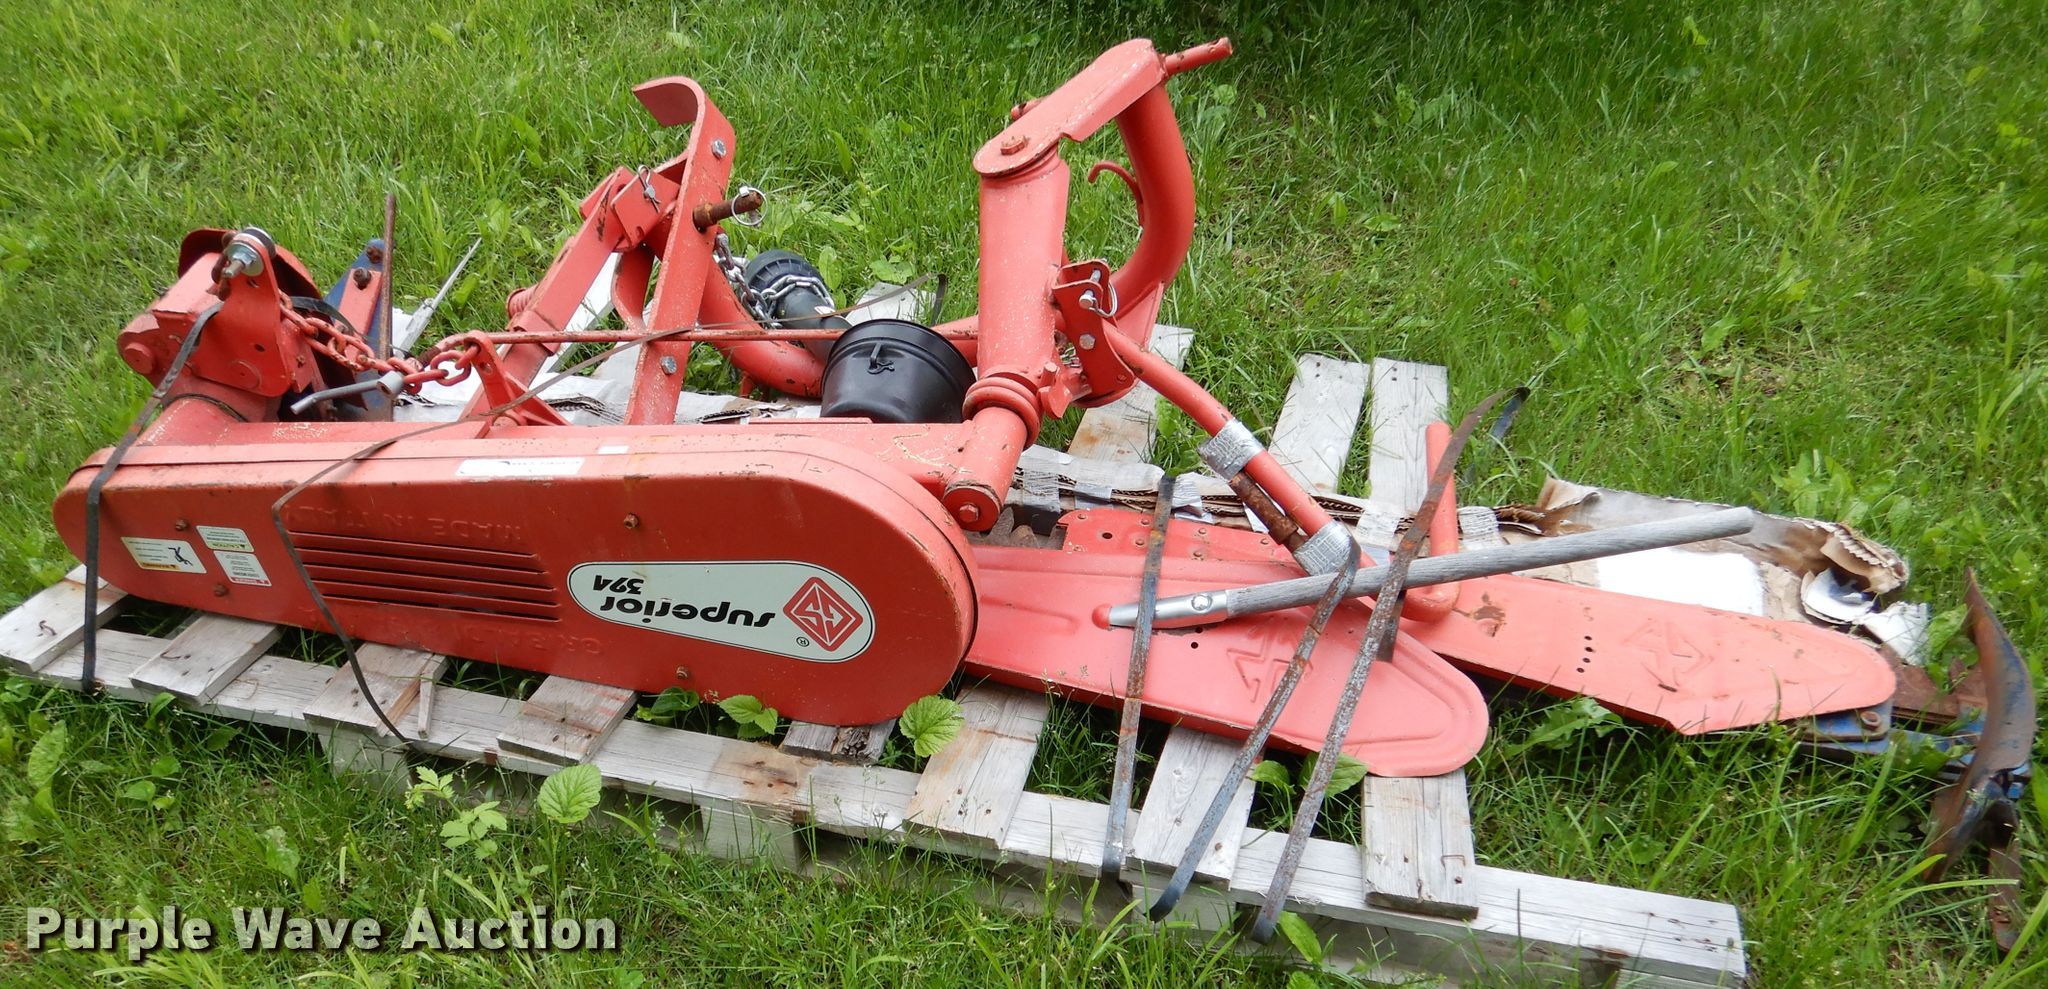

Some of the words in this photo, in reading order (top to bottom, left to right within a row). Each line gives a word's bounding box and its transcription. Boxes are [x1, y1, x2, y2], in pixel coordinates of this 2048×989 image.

[427, 517, 521, 541] MADE
[593, 574, 644, 595] 394
[600, 596, 775, 628] superior
